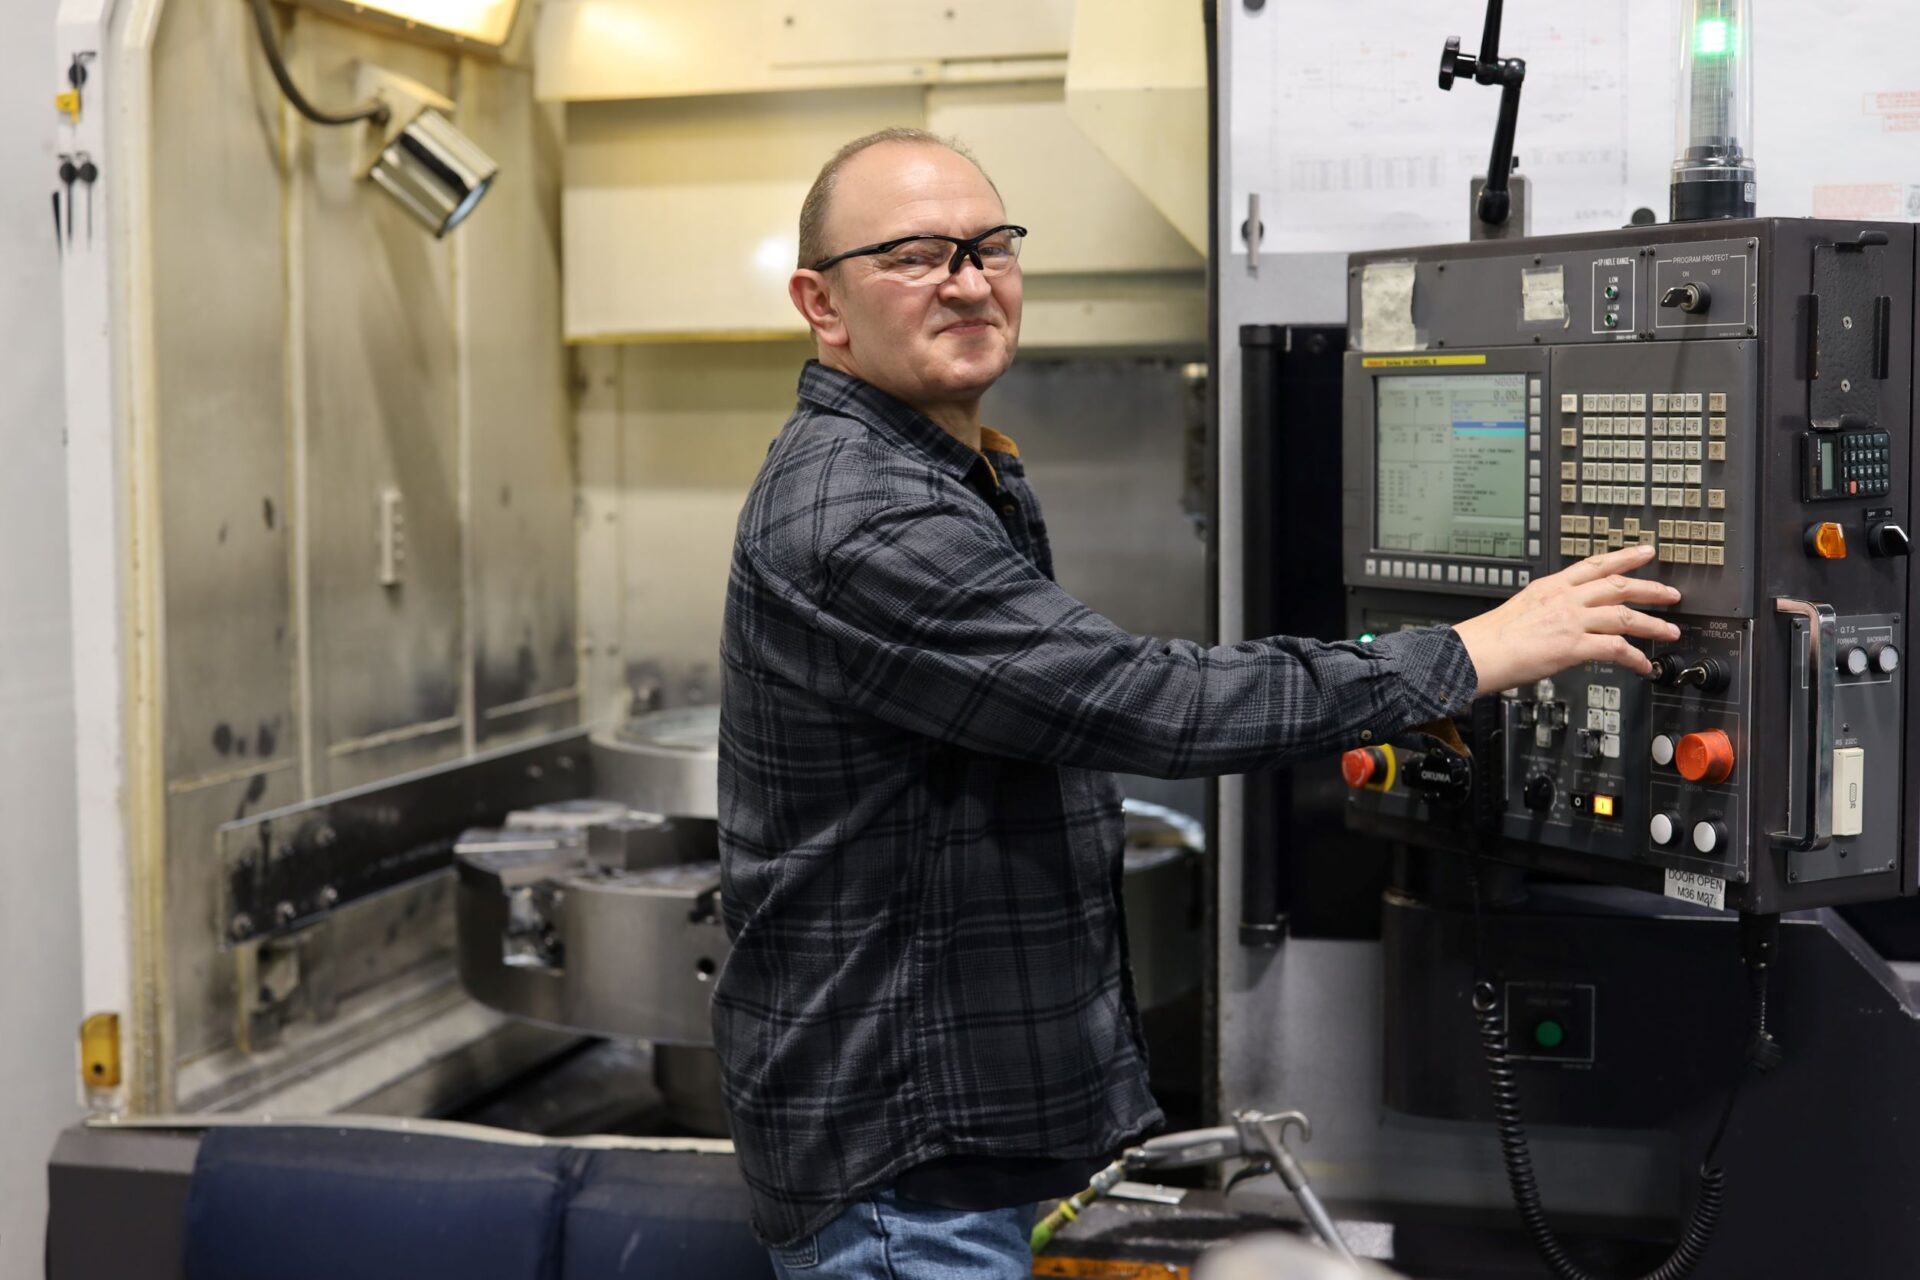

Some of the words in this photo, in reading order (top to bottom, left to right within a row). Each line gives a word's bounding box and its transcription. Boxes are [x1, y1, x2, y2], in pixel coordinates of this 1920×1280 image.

[1597, 257, 1616, 267] SPINDLE
[1616, 256, 1630, 265] RANGE
[1672, 255, 1701, 264] PROGRAM
[1701, 253, 1729, 262] PROTECT
[1682, 270, 1690, 278] ON
[1711, 268, 1721, 276] OFF
[1608, 276, 1619, 284] LOW
[1709, 621, 1728, 630] DOOR
[1702, 629, 1735, 640] INTERLOCK
[1837, 636, 1858, 645] FORWARD
[1866, 634, 1890, 644] BACKWARD
[1729, 649, 1740, 657] OFF
[1421, 769, 1452, 784] OKUMA
[1668, 869, 1695, 885] DOOR
[1696, 875, 1723, 893] OPEN
[1677, 885, 1695, 900] M36
